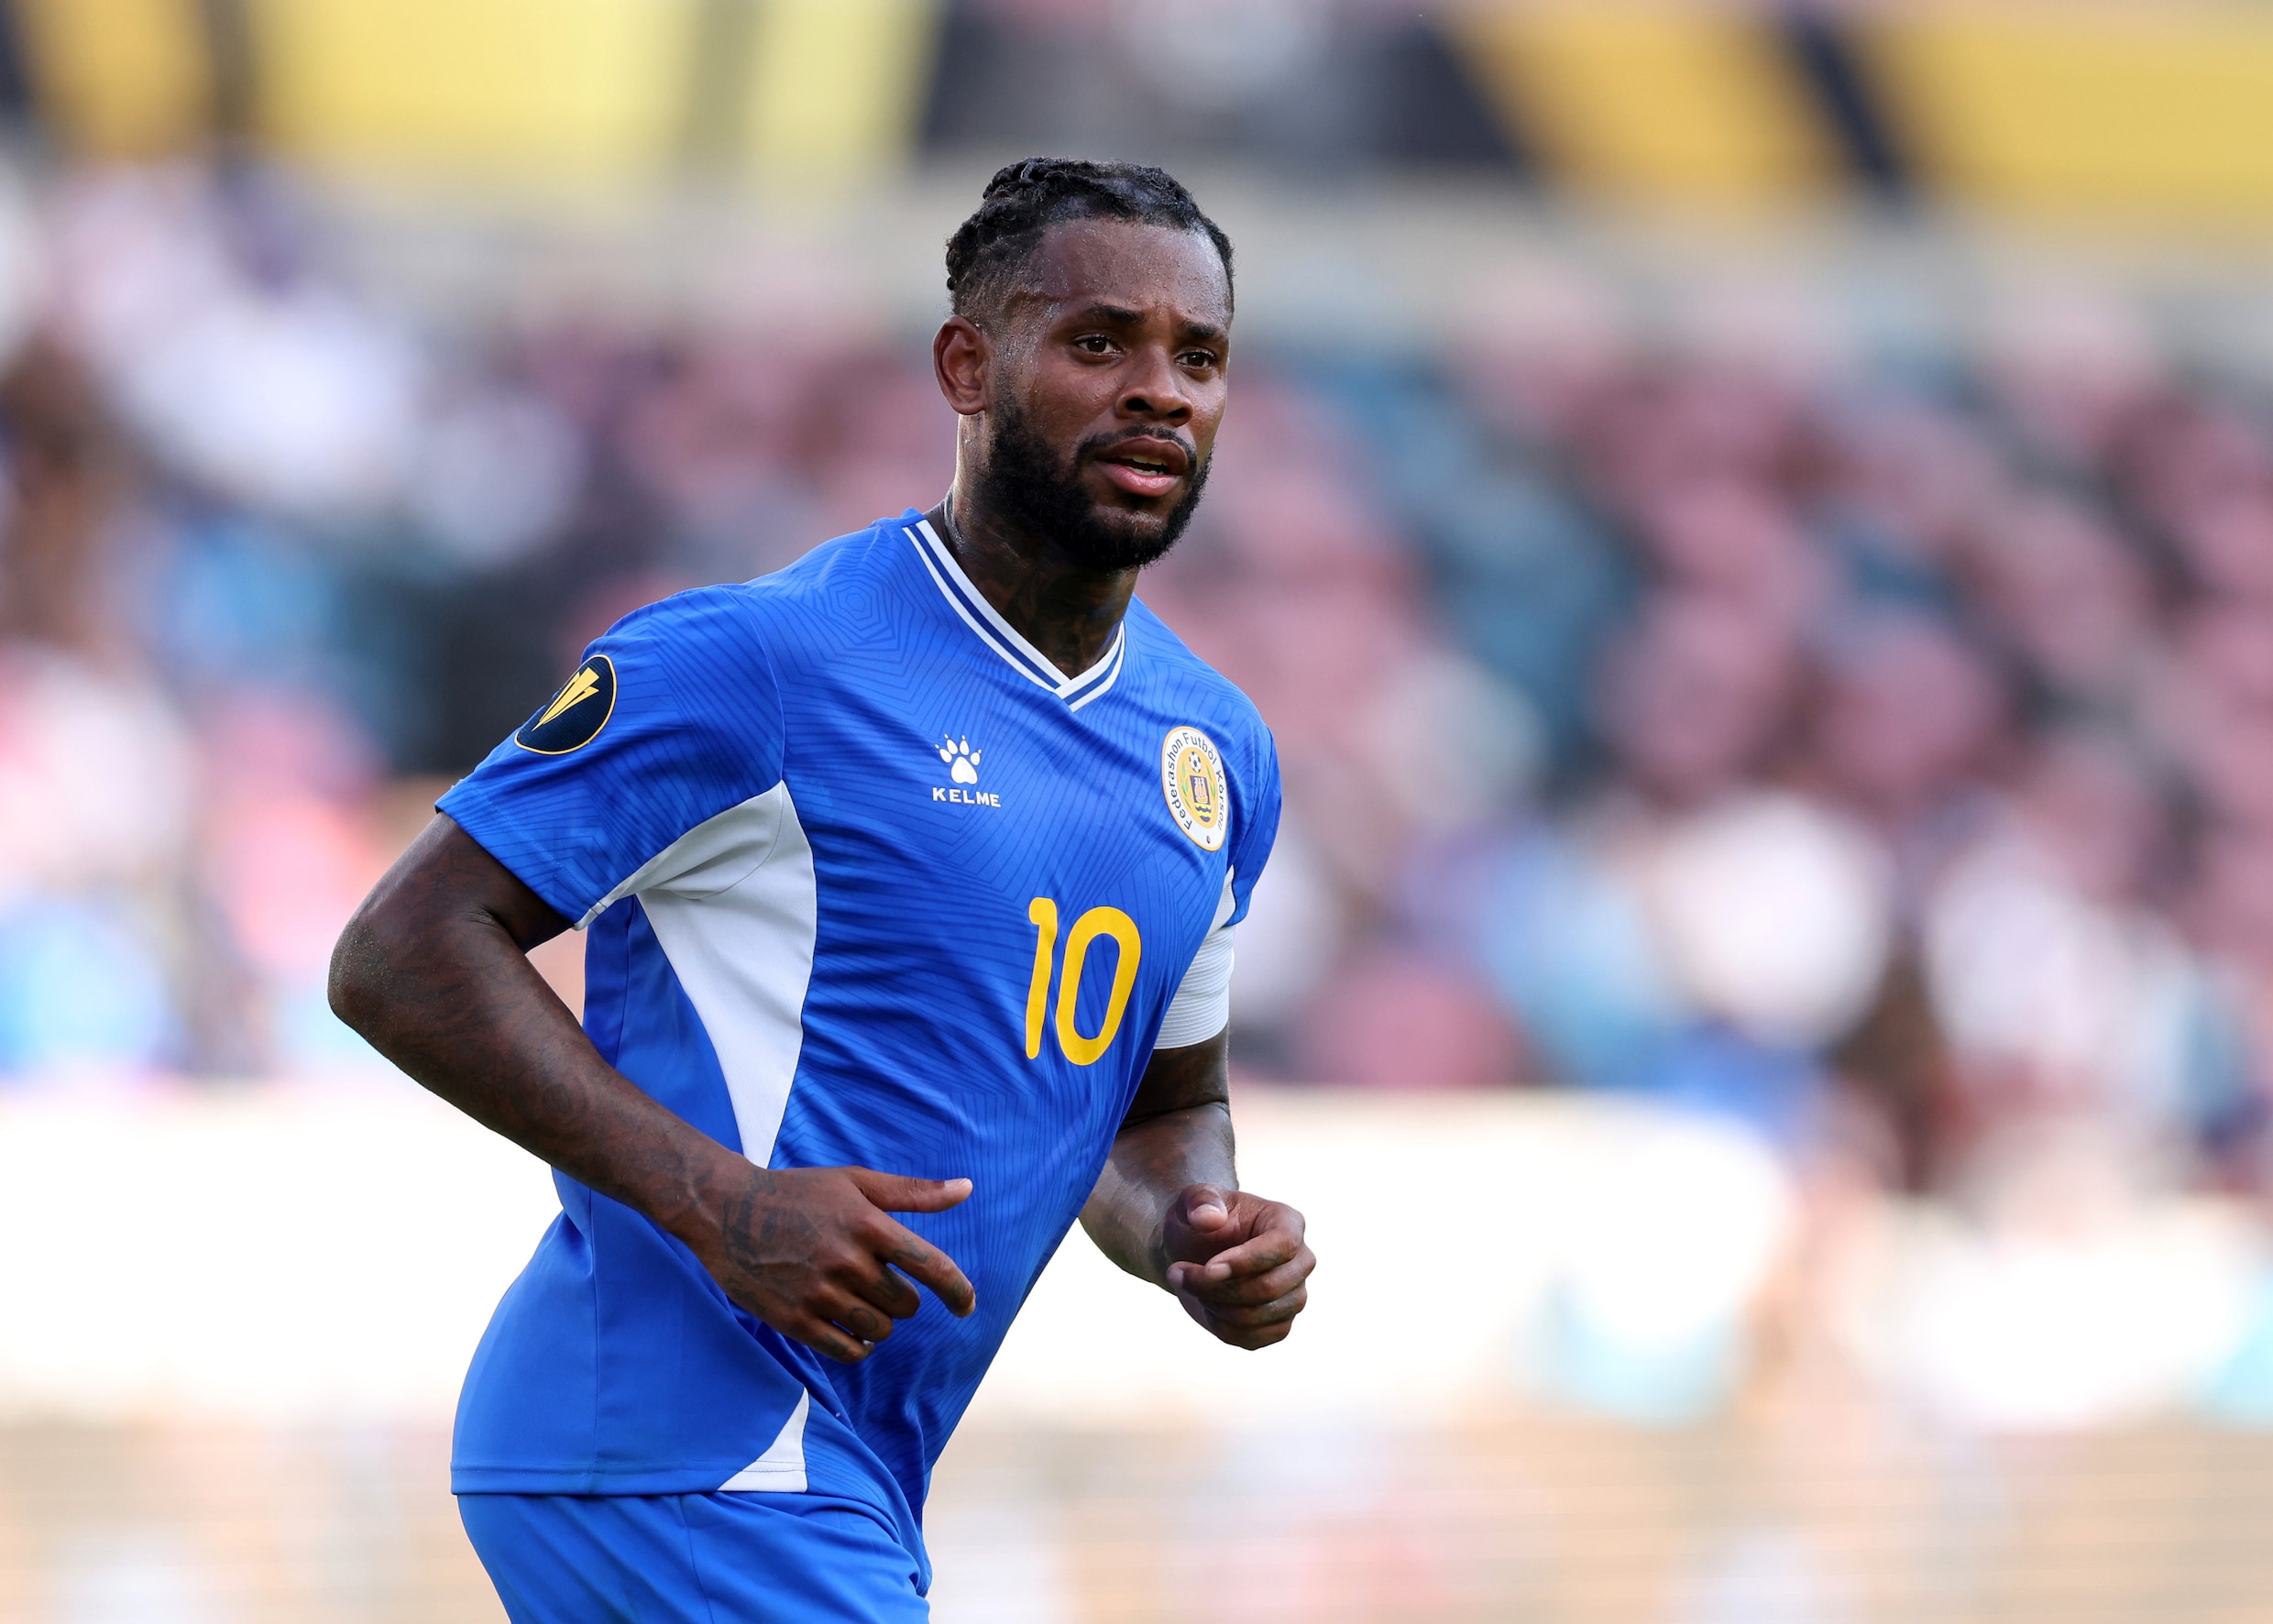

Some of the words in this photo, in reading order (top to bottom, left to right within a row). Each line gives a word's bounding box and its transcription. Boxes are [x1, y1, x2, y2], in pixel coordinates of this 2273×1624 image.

[932, 786, 1002, 808] KELME
[1167, 739, 1192, 830] Federashon
[1026, 896, 1142, 1066] 10
